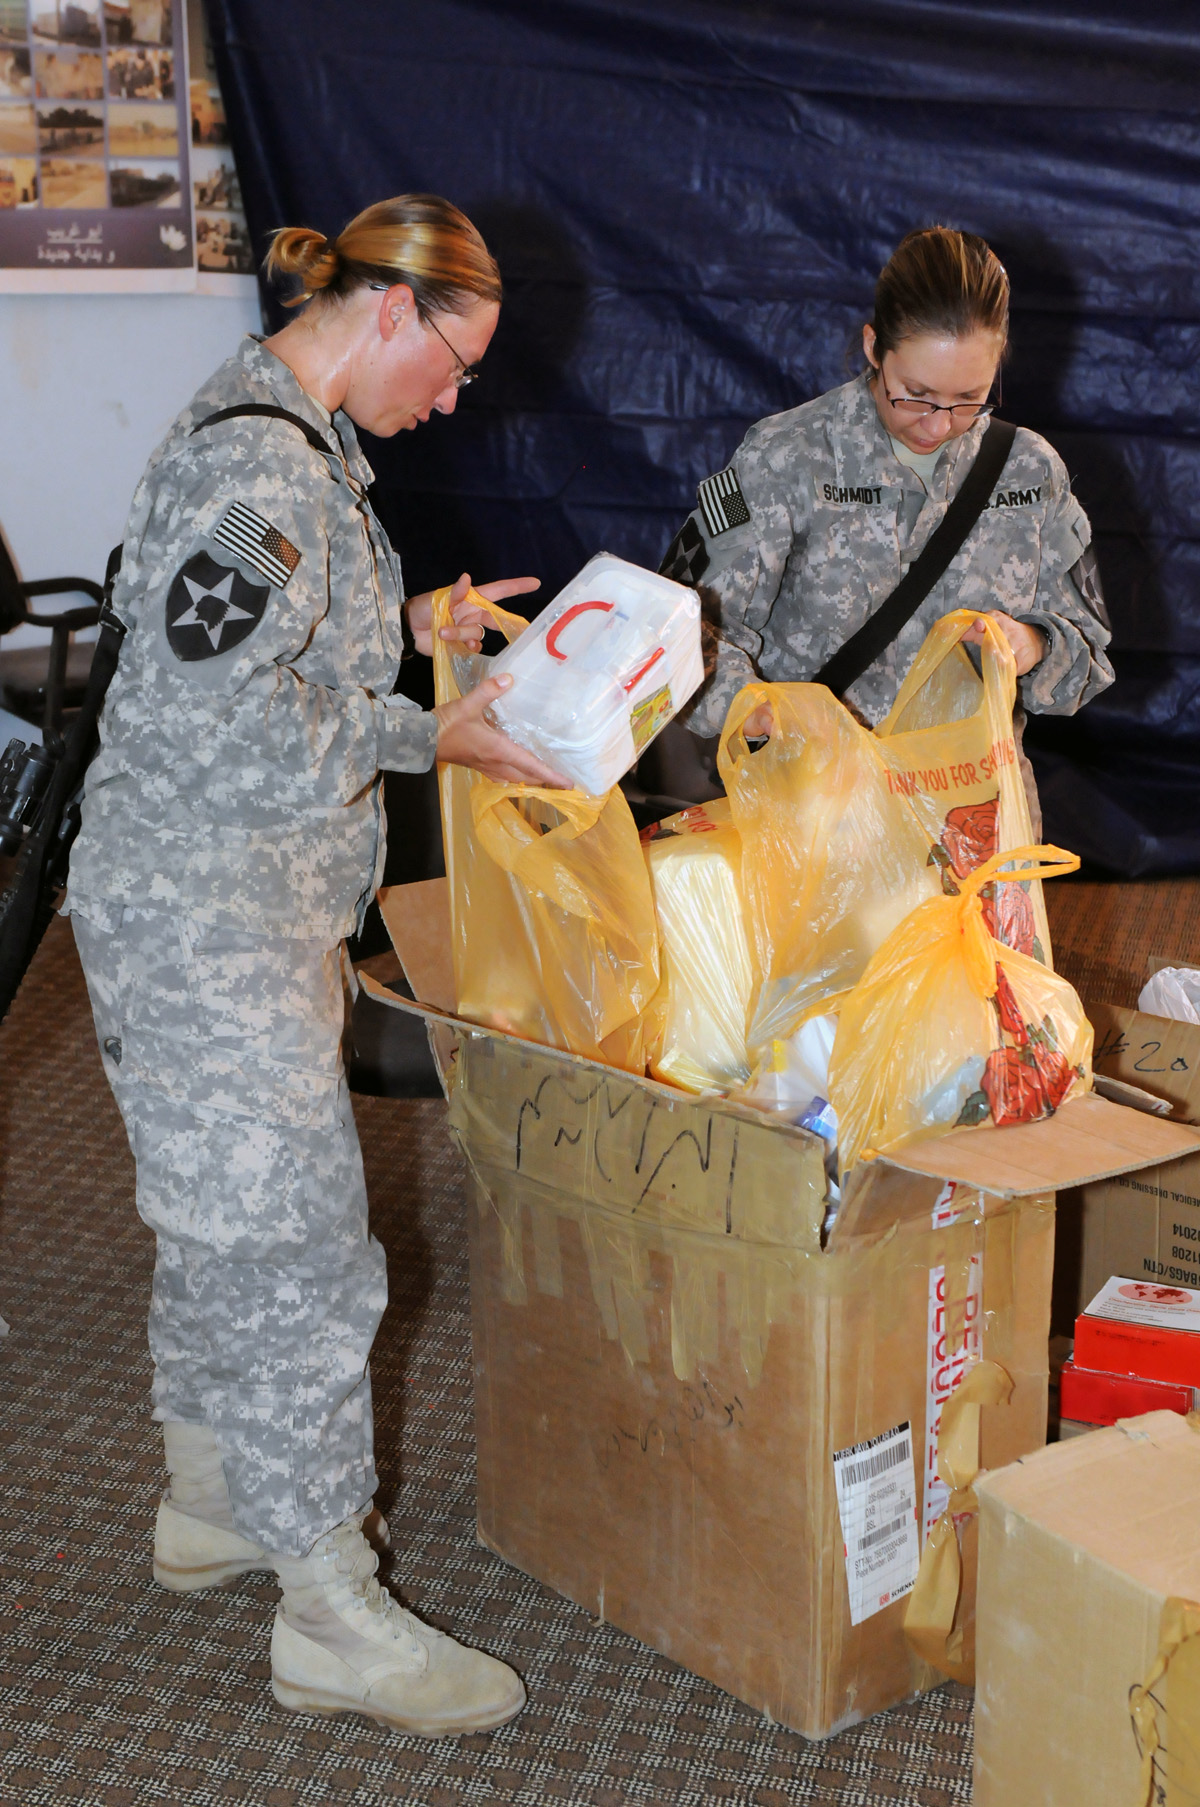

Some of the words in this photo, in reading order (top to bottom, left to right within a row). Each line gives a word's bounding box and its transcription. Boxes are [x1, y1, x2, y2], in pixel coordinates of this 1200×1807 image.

[823, 483, 882, 505] SCHMIDT
[917, 767, 949, 792] YOU
[950, 762, 982, 788] FOR
[1131, 1180, 1169, 1199] DRESSING
